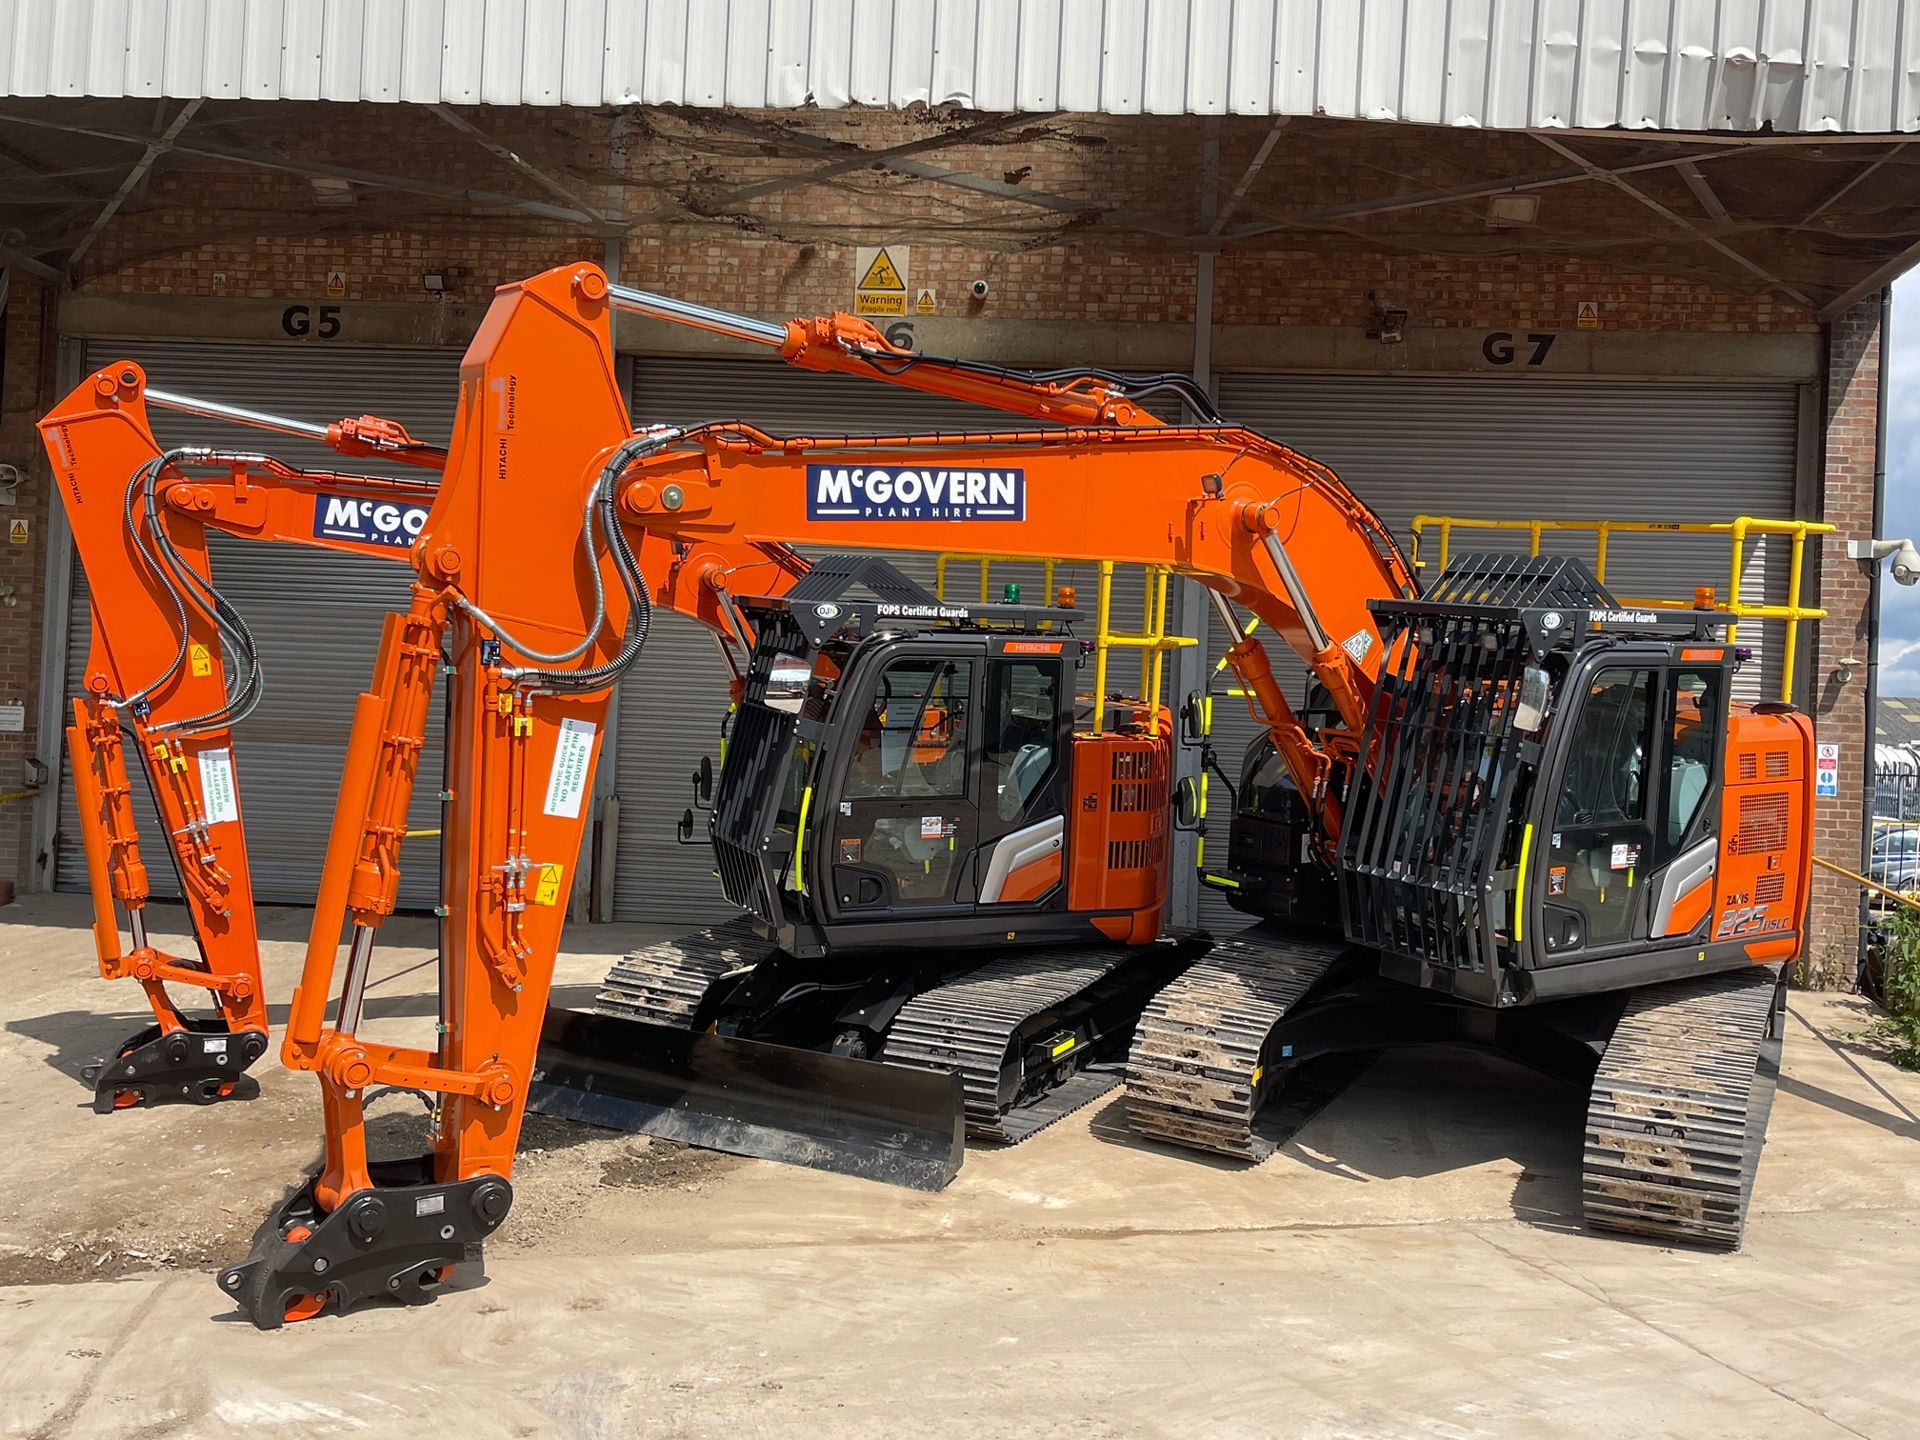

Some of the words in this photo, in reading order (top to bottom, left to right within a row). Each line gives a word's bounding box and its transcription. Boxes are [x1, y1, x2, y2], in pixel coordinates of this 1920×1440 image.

[860, 295, 903, 306] Warning
[507, 375, 517, 430] Technology
[499, 438, 507, 480] HITACHI
[68, 472, 83, 504] HITACHI
[324, 498, 428, 535] McGO
[865, 507, 921, 517] PLANT
[932, 508, 972, 518] HIRE
[371, 533, 416, 545] PLAN
[877, 604, 900, 615] FOPS
[902, 605, 938, 617] Certified
[939, 607, 968, 618] Guards
[1589, 610, 1607, 622] FOPS
[1608, 611, 1635, 623] Certified
[1635, 612, 1657, 624] Guards
[571, 733, 580, 749] PIN
[550, 770, 563, 812] AUTOMATIC
[559, 745, 568, 768] QUICK
[564, 720, 574, 743] HITCH
[563, 751, 576, 787] SAFETY
[571, 746, 586, 792] REQUIRED
[560, 789, 568, 802] NO
[1716, 905, 1768, 939] 225
